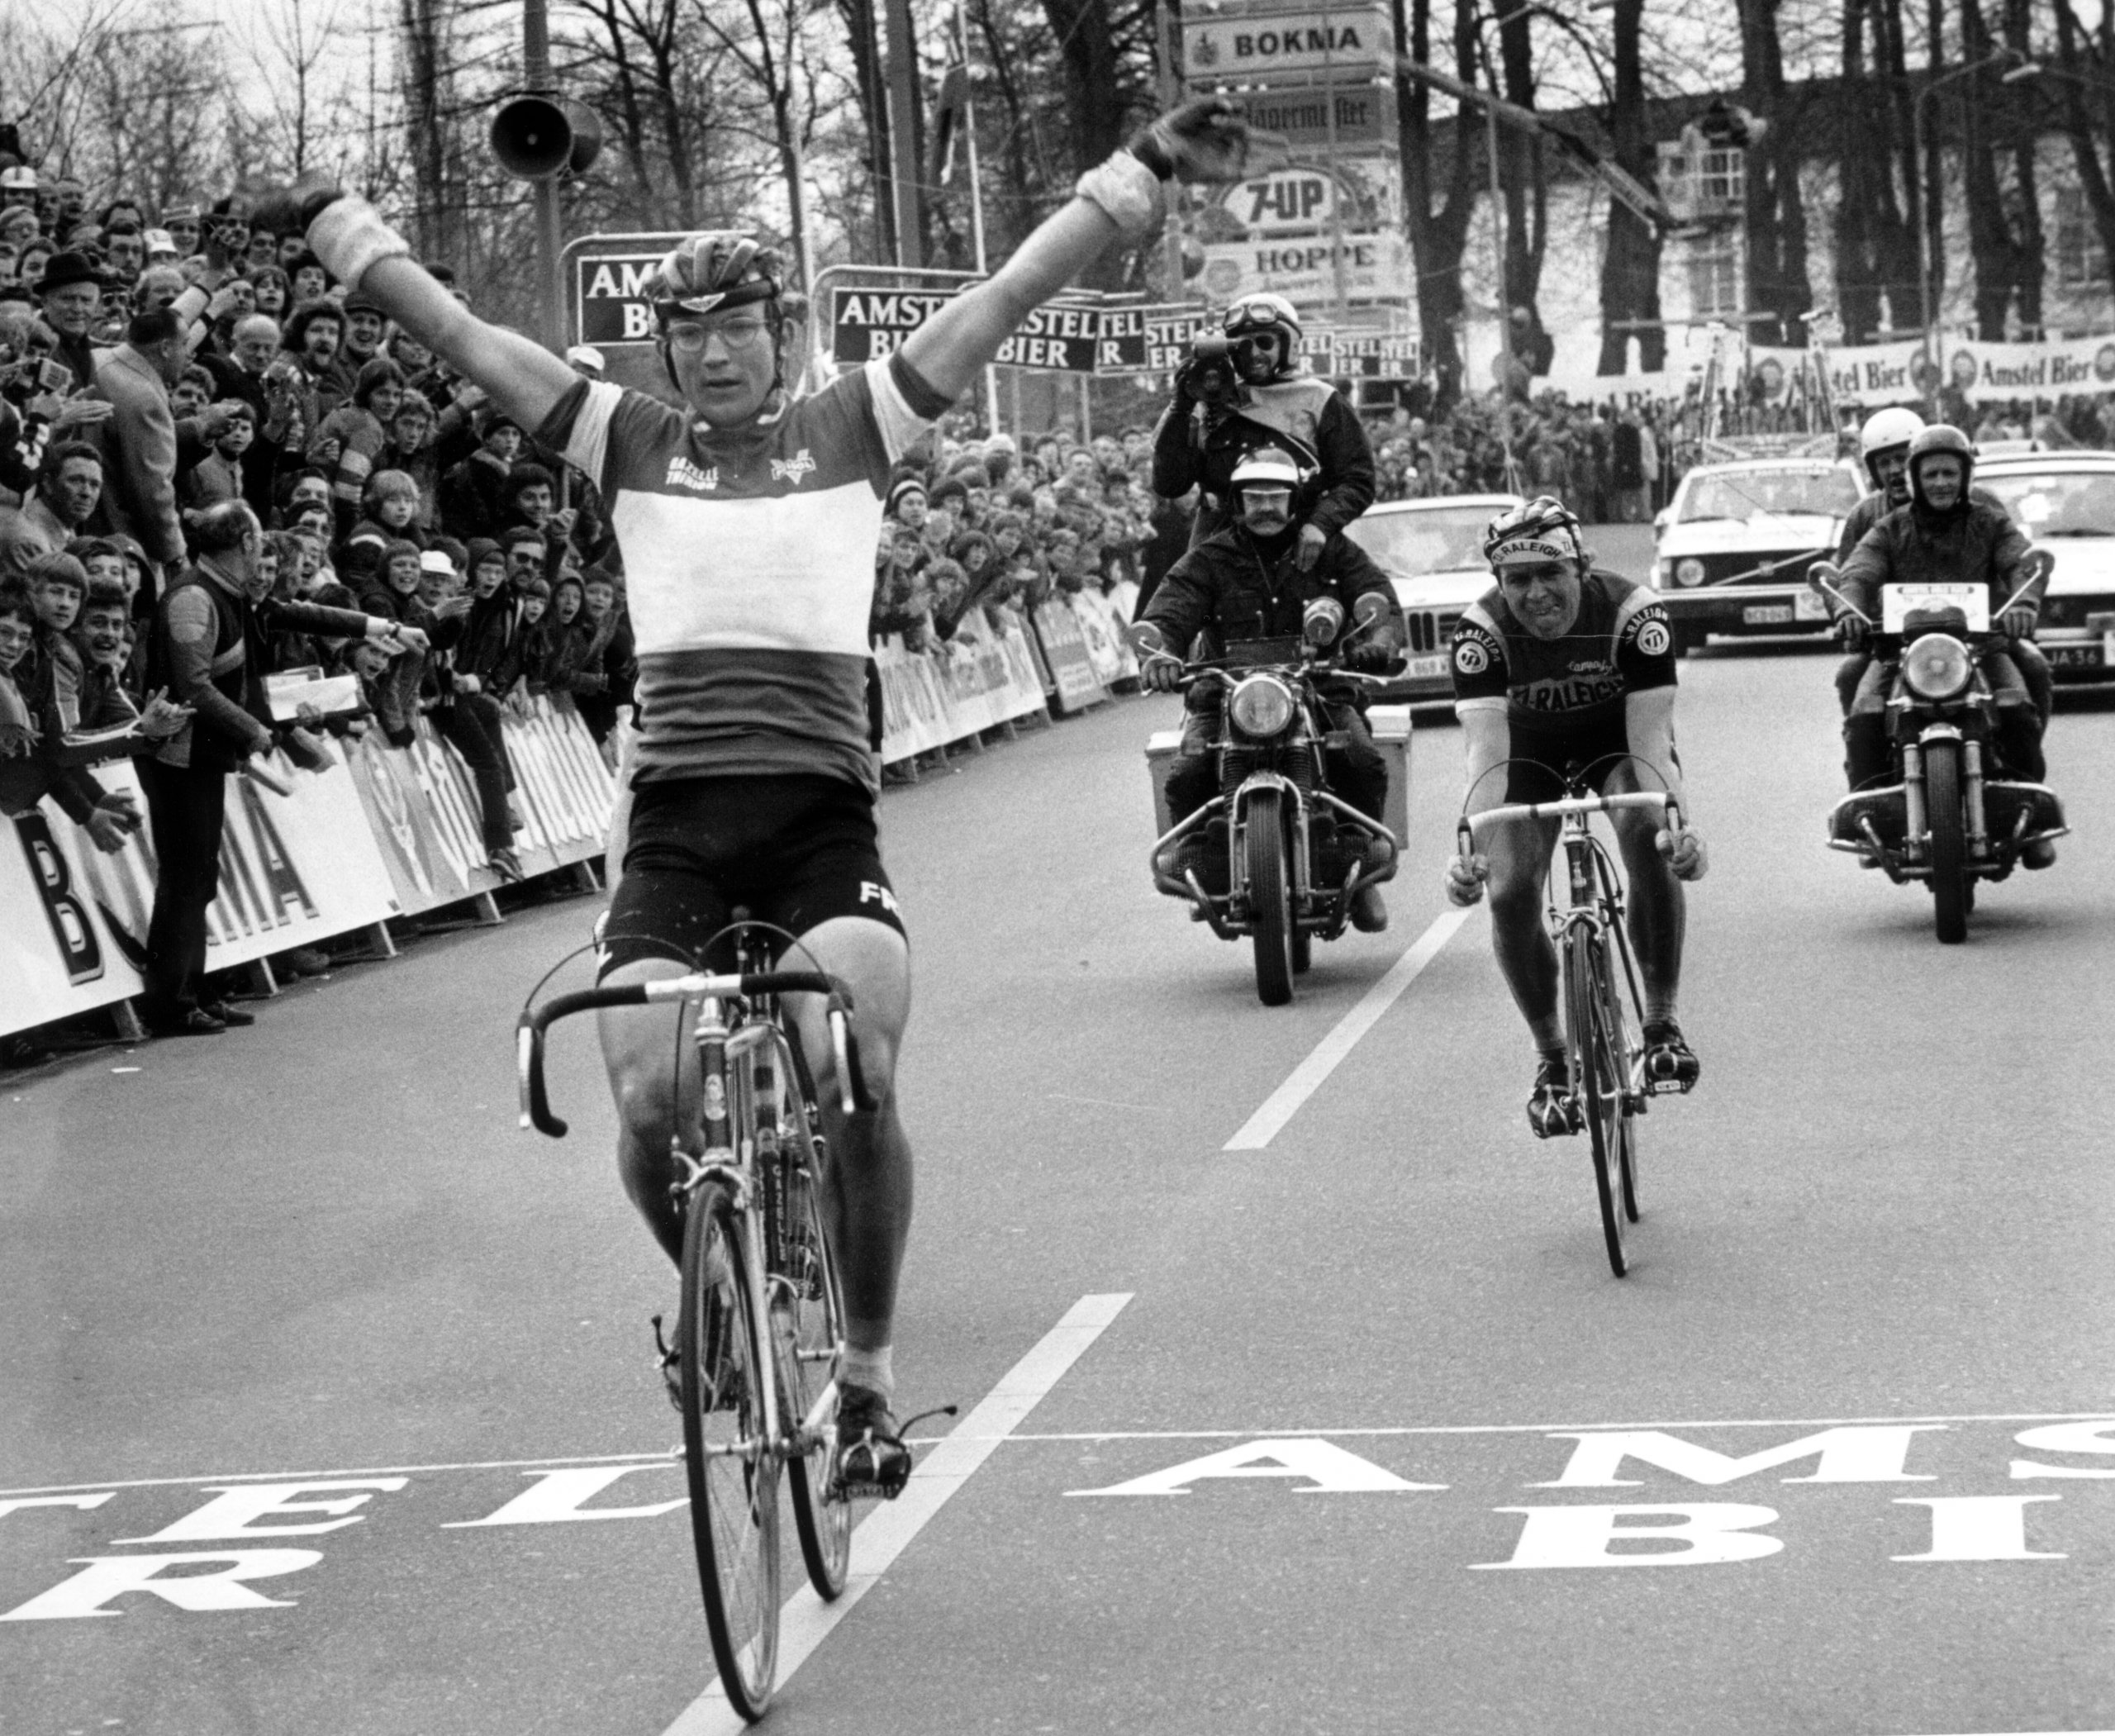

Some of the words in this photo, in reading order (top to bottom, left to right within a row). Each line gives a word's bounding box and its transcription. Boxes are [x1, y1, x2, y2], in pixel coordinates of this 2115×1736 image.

[1256, 245, 1375, 273] HOPPE
[838, 294, 950, 326] AMST
[1016, 307, 1097, 340] STEL
[870, 329, 910, 359] BI
[994, 335, 1070, 369] BIER
